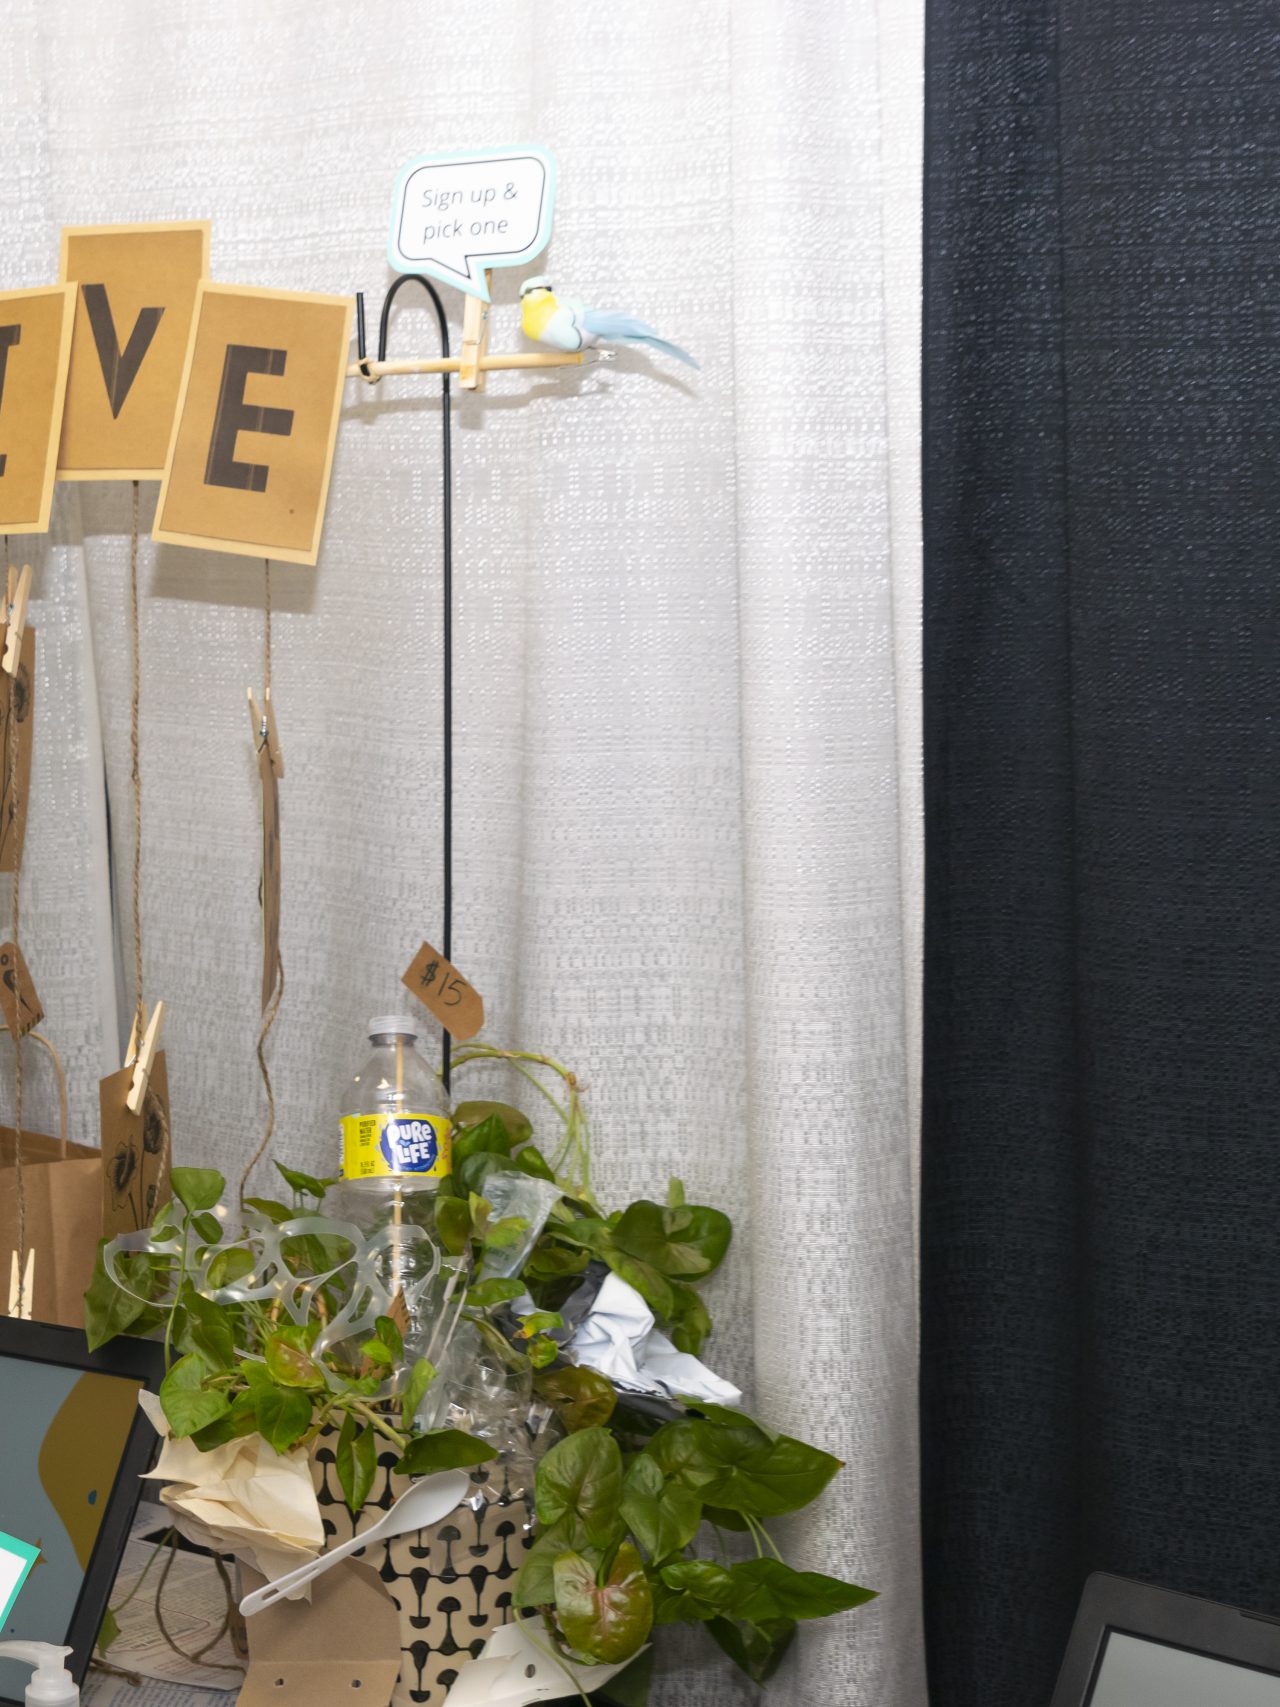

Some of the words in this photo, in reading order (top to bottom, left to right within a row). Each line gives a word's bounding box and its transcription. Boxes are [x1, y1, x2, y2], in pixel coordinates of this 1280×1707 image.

[422, 188, 463, 212] Sign
[470, 188, 497, 208] up
[503, 182, 519, 200] &
[423, 218, 463, 244] pick
[469, 218, 509, 236] one
[420, 960, 467, 1006] $15
